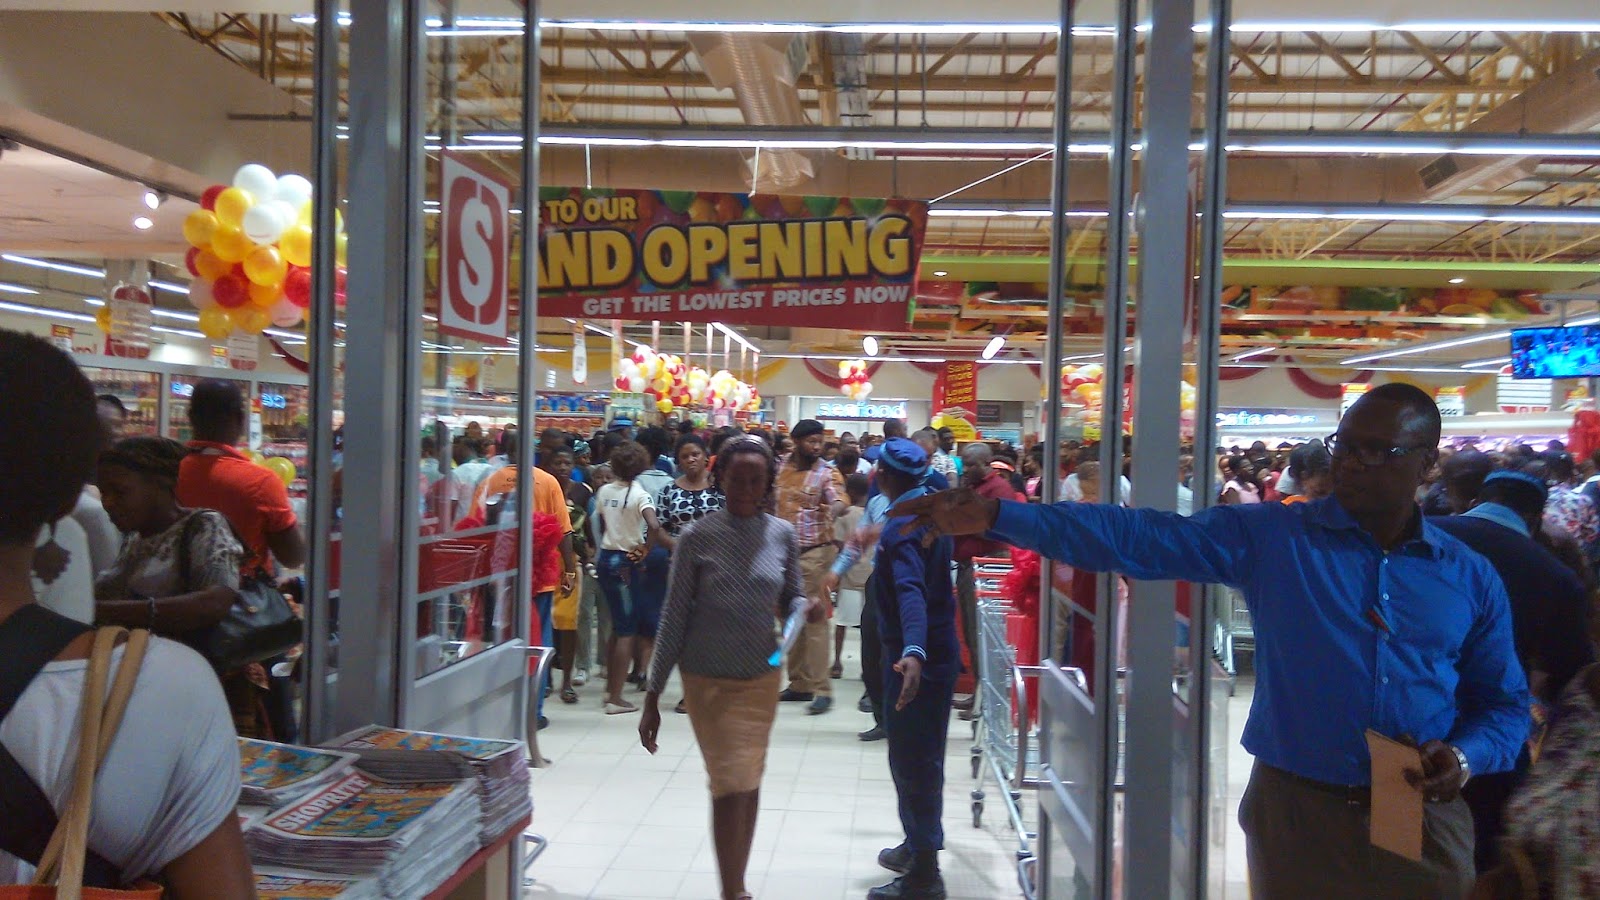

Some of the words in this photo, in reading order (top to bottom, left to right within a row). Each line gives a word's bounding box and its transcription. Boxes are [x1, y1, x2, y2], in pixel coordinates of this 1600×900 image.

[546, 199, 579, 224] TO
[583, 196, 639, 223] OUR
[642, 216, 910, 286] OPENING
[583, 297, 625, 316] GET
[631, 295, 672, 313] THE
[678, 291, 766, 312] LOWEST
[772, 287, 847, 307] PRICES
[853, 285, 909, 304] NOW
[947, 363, 972, 374] Save
[947, 371, 973, 381] more
[816, 401, 908, 419] seafood
[274, 774, 371, 832] SHOPRITE
